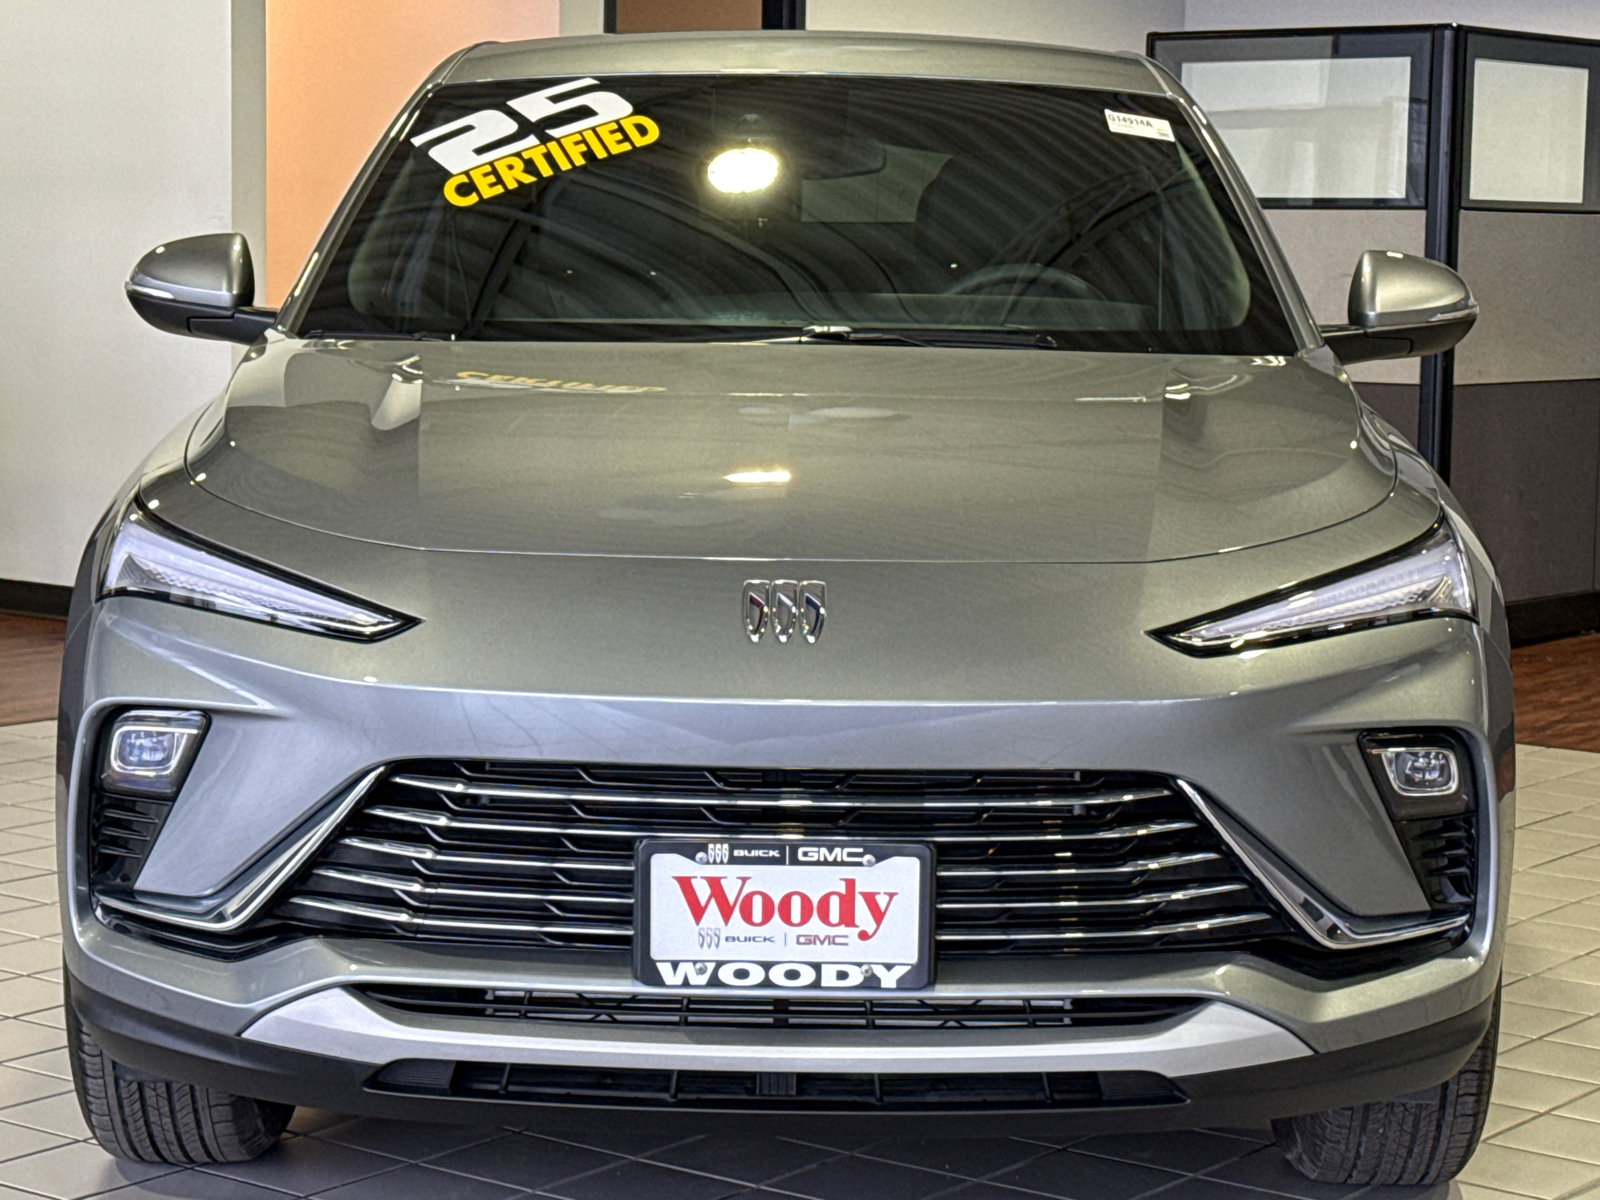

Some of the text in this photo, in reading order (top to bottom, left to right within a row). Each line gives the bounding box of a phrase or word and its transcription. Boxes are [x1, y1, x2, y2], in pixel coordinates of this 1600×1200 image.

[410, 77, 634, 175] 25
[443, 115, 660, 207] CERTIFIED
[733, 847, 864, 862] BUICK GMC
[671, 875, 899, 941] Woody
[724, 934, 849, 946] BUICK GMC
[655, 962, 912, 989] WOODY
